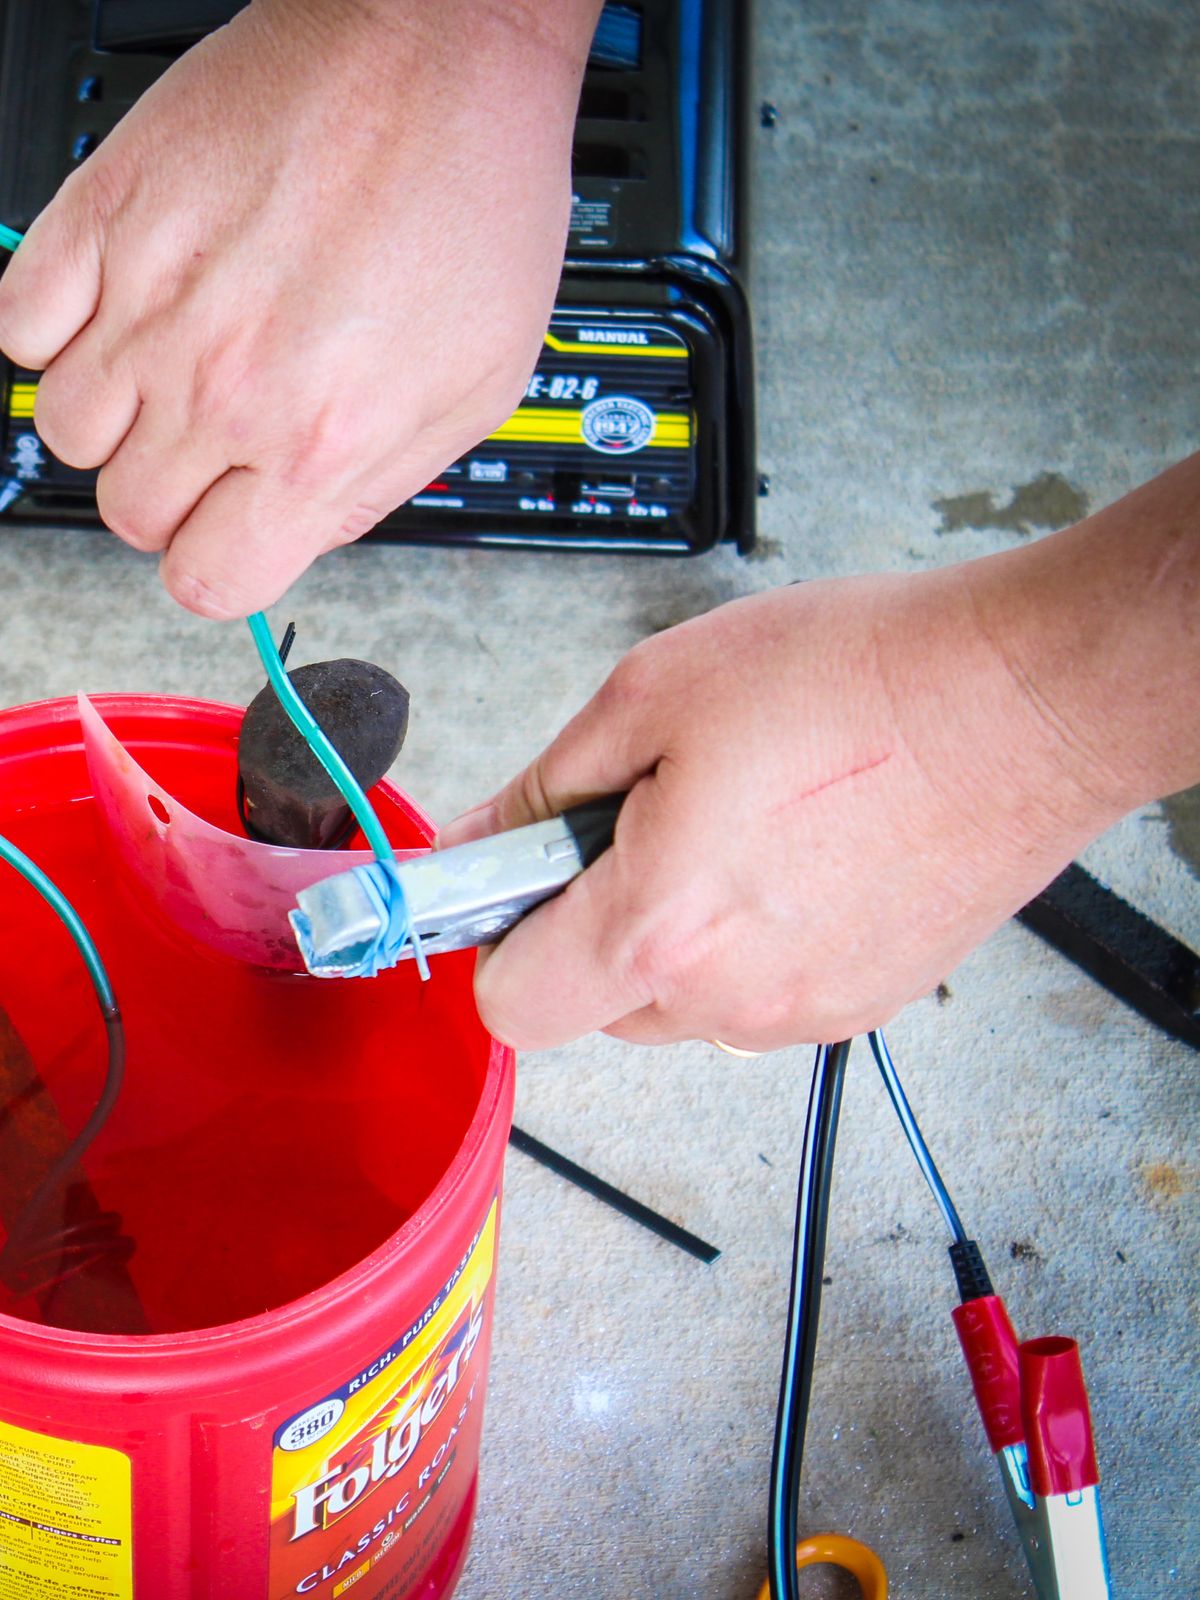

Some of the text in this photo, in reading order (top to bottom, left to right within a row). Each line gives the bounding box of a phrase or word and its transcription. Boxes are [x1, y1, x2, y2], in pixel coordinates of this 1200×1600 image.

[578, 329, 649, 345] MANUAL
[402, 1296, 441, 1348] PURE
[288, 1299, 484, 1542] Folgers
[290, 1409, 335, 1445] 380
[19, 1446, 76, 1465] PURE COFFEE
[21, 1459, 51, 1471] COFFEE
[54, 1469, 98, 1481] COMPANY
[295, 1491, 410, 1593] CLASSIC
[418, 1376, 478, 1489] ROAST
[13, 1498, 51, 1514] Coffee
[55, 1510, 102, 1525] Makers
[37, 1523, 78, 1539] Folgers
[81, 1534, 119, 1545] Coffee
[45, 1532, 93, 1548] Tablespoon
[55, 1541, 119, 1558] Measuring Cup
[18, 1569, 41, 1581] tipo
[44, 1578, 60, 1586] de
[62, 1582, 120, 1598] cafeteras
